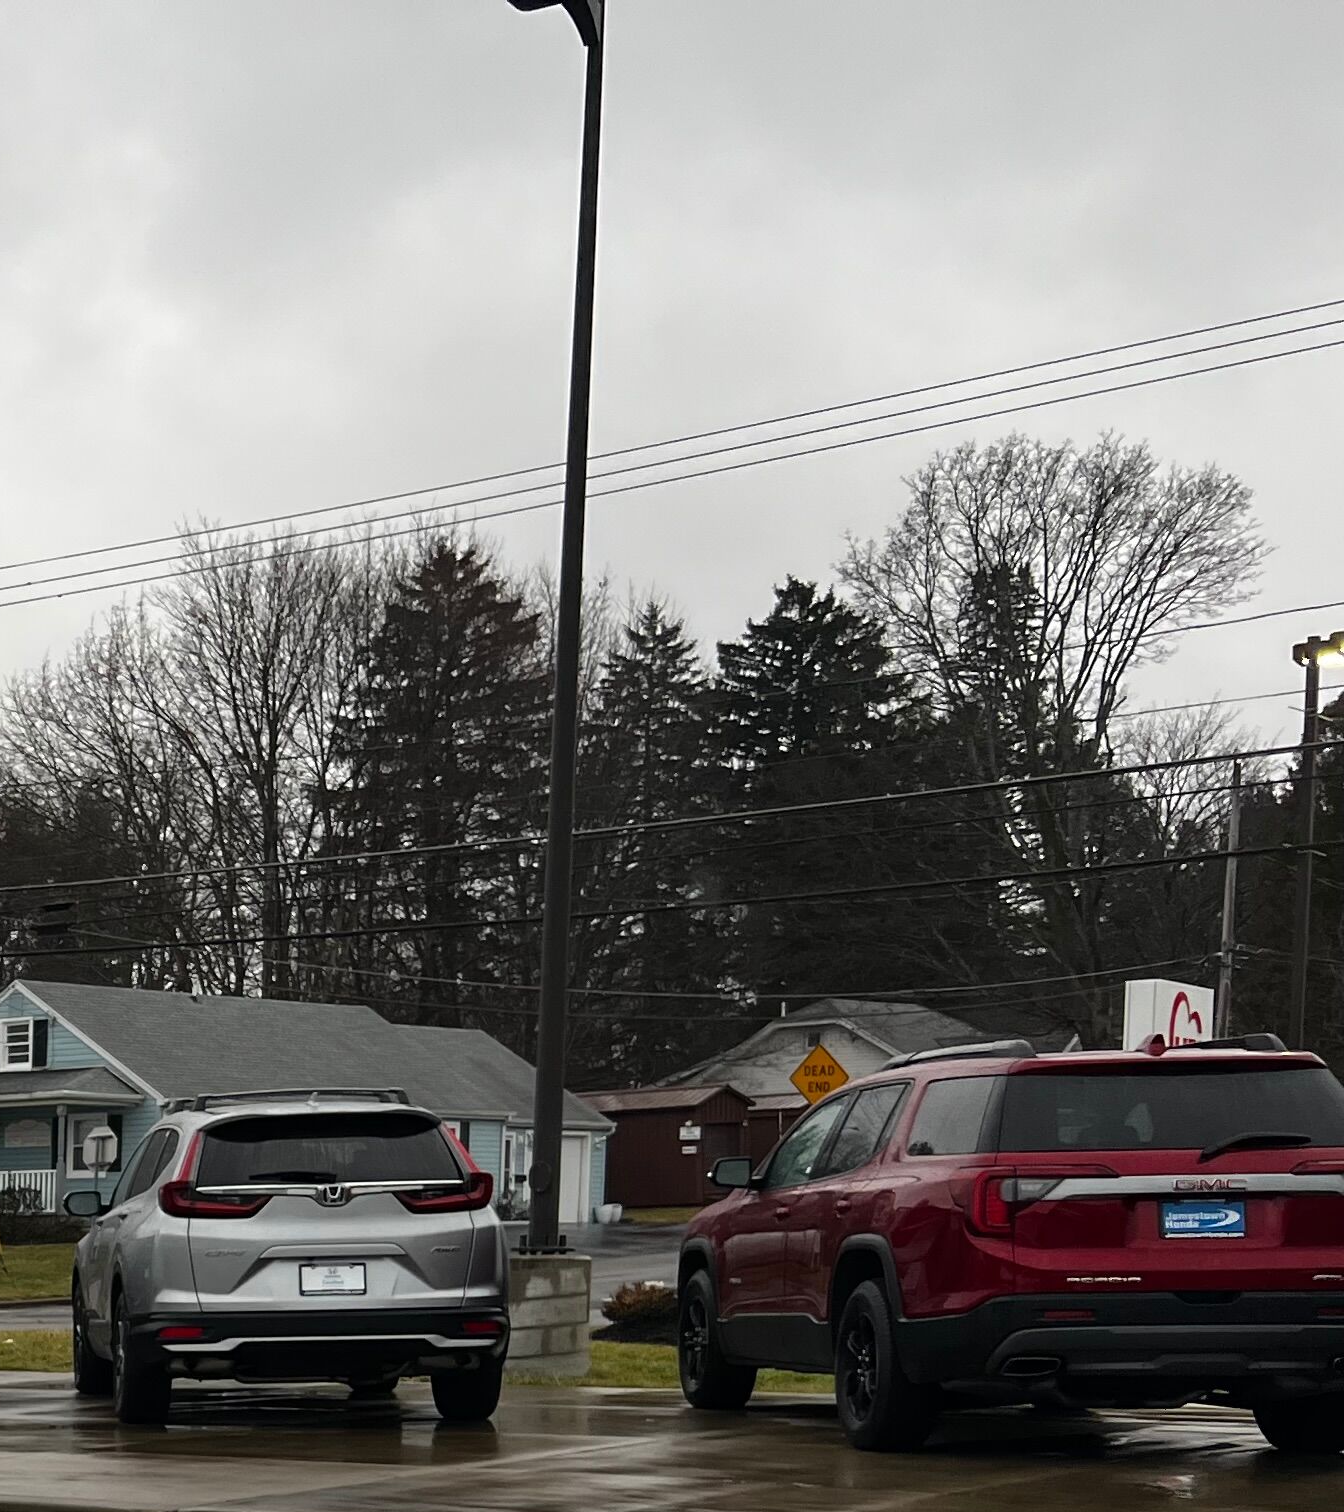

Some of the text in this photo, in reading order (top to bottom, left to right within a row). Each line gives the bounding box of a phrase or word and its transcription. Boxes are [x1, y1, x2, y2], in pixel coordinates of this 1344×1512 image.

[804, 1065, 835, 1077] DEAD
[808, 1082, 831, 1093] END
[1173, 1178, 1248, 1192] GMC
[1165, 1220, 1200, 1229] Honda
